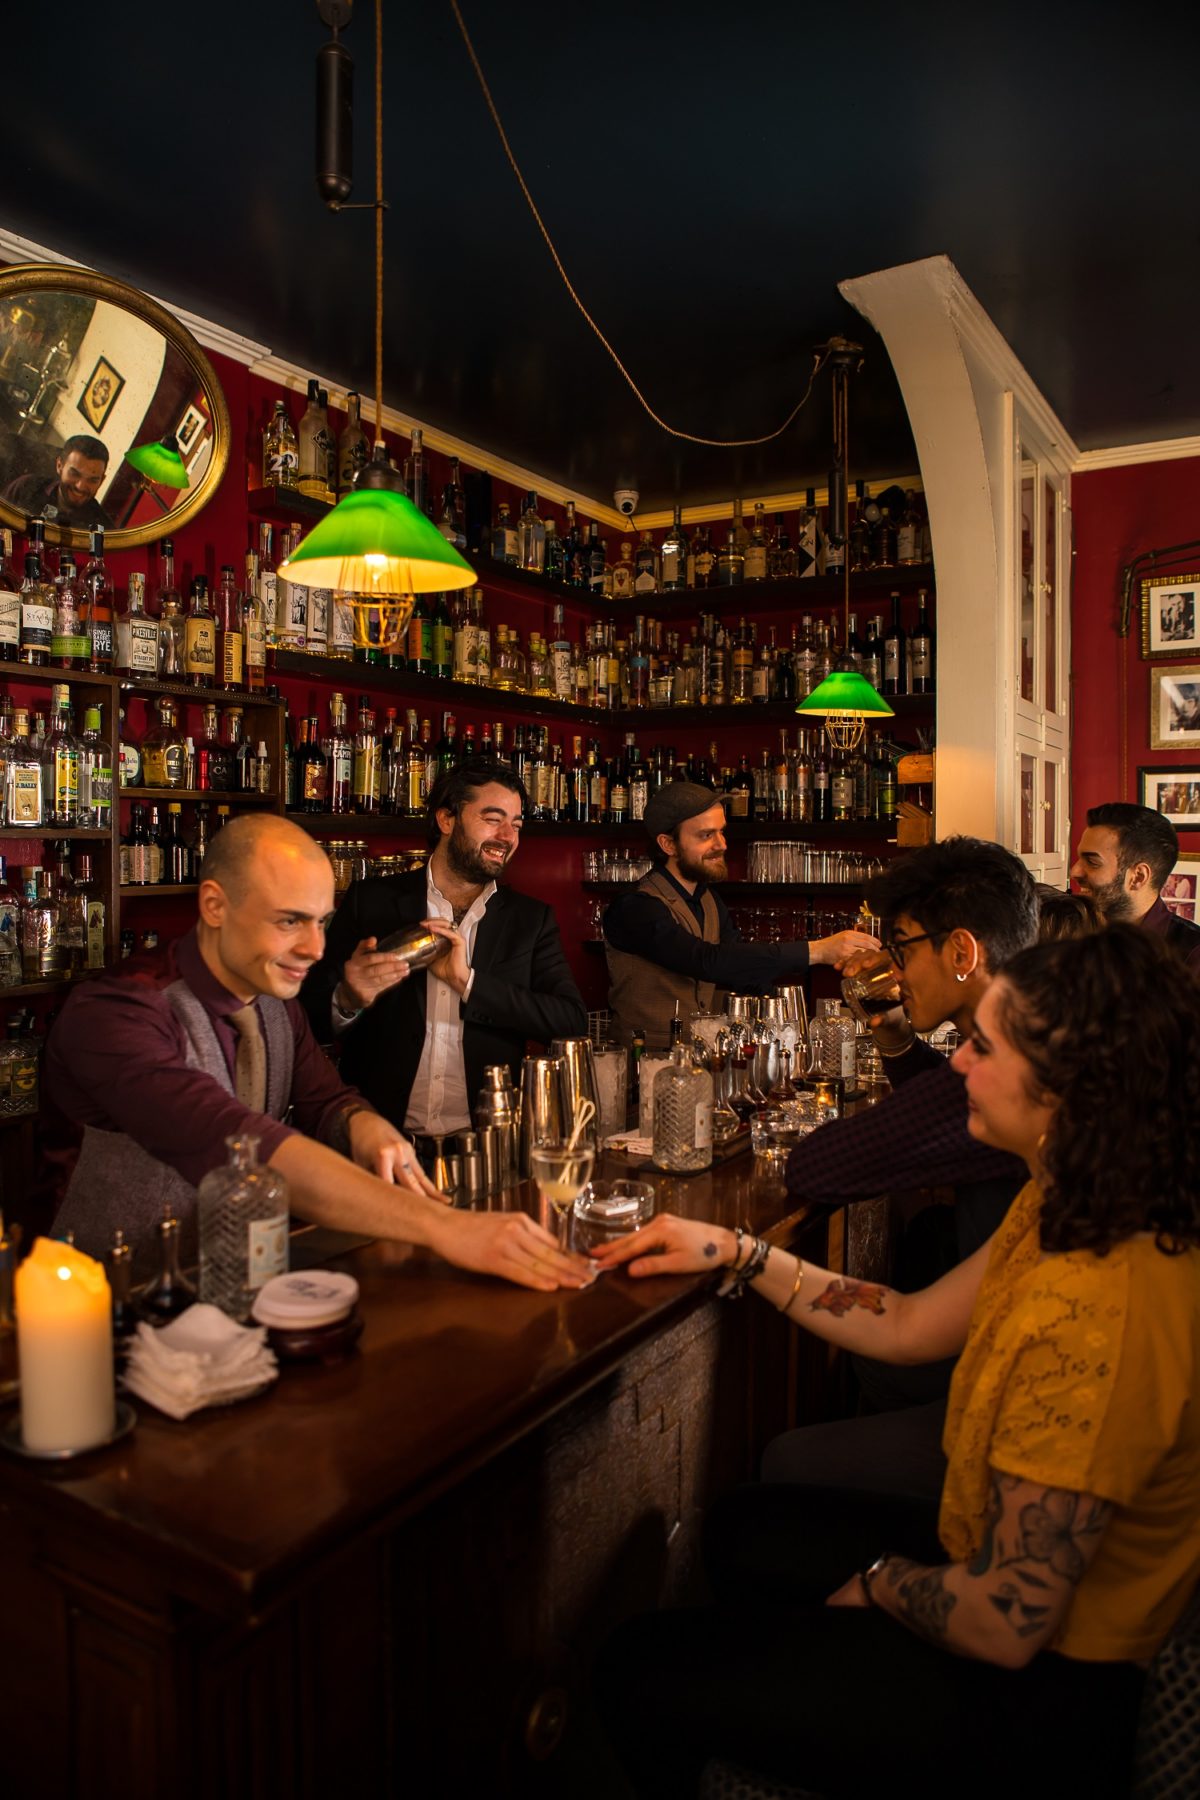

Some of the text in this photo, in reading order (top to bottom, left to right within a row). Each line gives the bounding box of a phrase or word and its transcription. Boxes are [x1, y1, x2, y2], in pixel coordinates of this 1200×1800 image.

[93, 629, 111, 637] SINGLE
[93, 640, 111, 652] RYE
[225, 633, 234, 681] REDEMPTION
